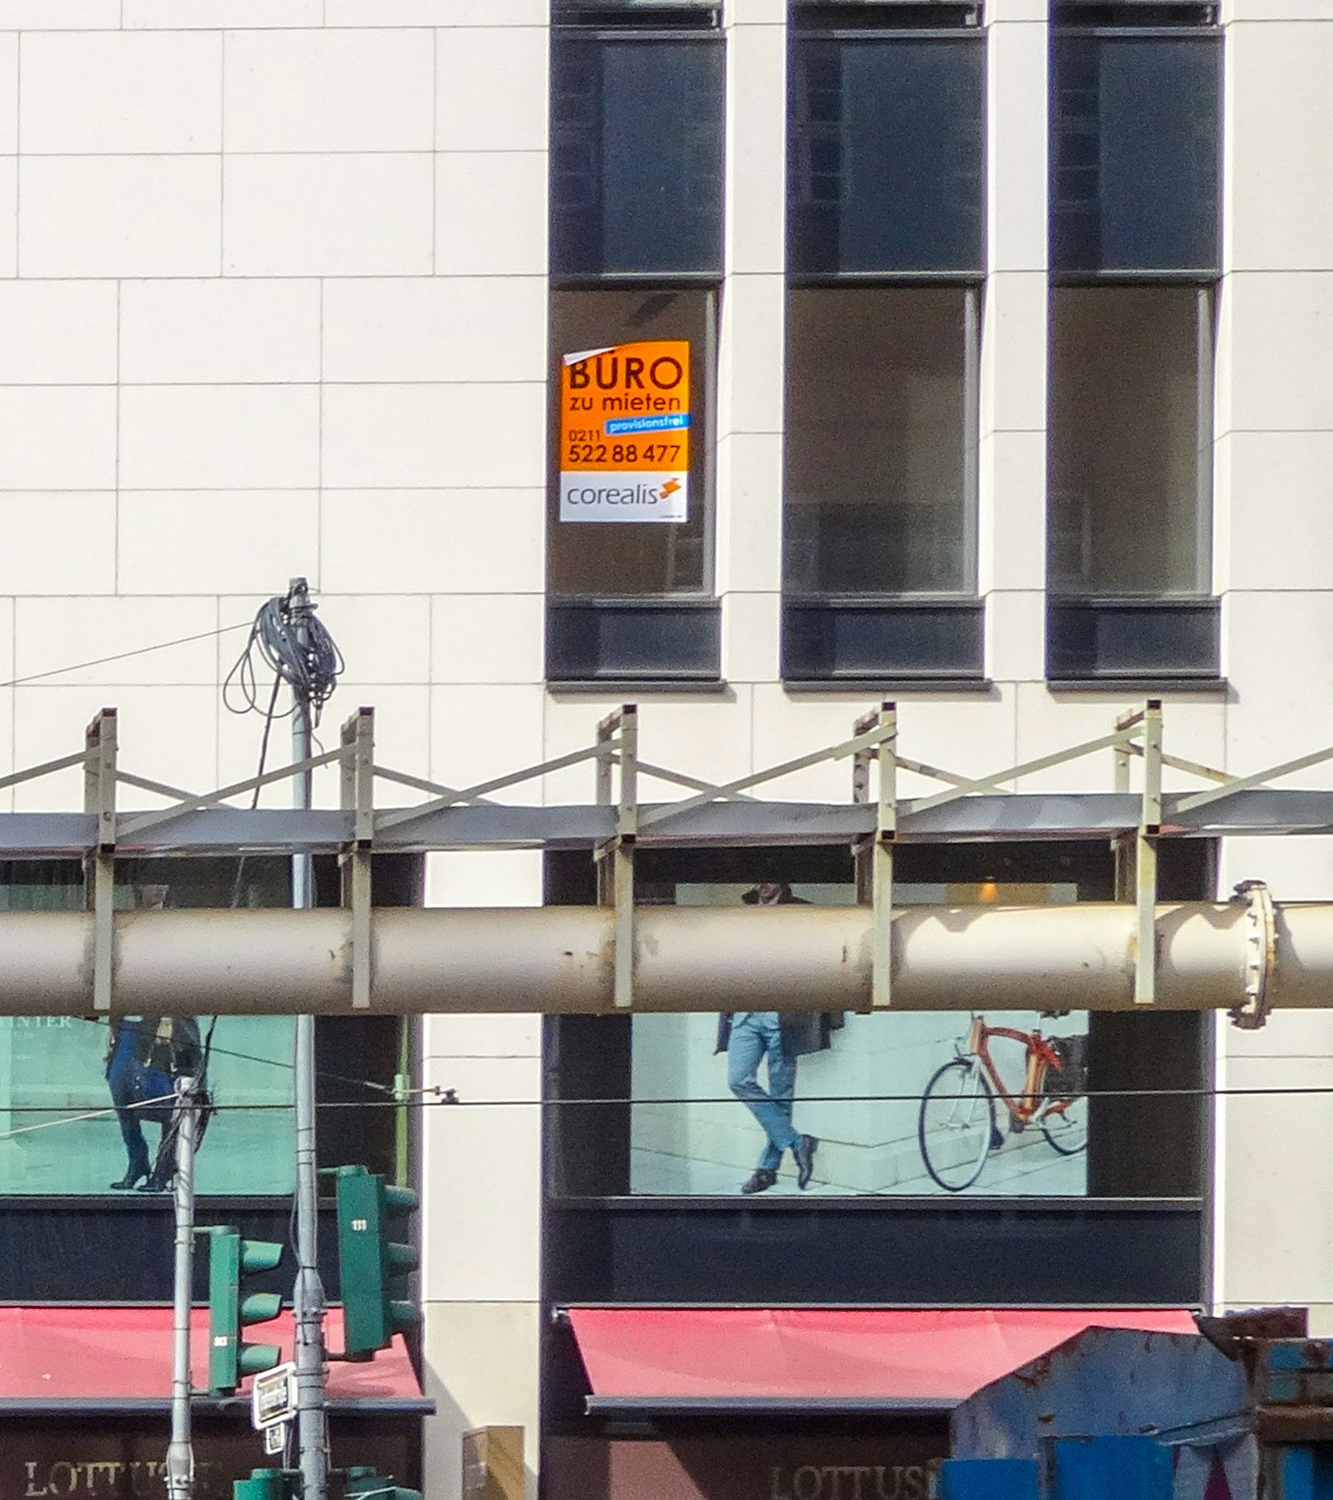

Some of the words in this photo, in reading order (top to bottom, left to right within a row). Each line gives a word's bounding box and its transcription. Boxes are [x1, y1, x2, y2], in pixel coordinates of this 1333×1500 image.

[569, 350, 682, 390] BÜRO
[569, 397, 593, 411] zu
[602, 393, 681, 411] mieten
[608, 415, 684, 432] provisionsfrei
[568, 430, 600, 442] 0211
[568, 445, 607, 463] 522
[612, 445, 638, 463] 88
[642, 445, 681, 463] 477
[567, 484, 658, 505] corealis
